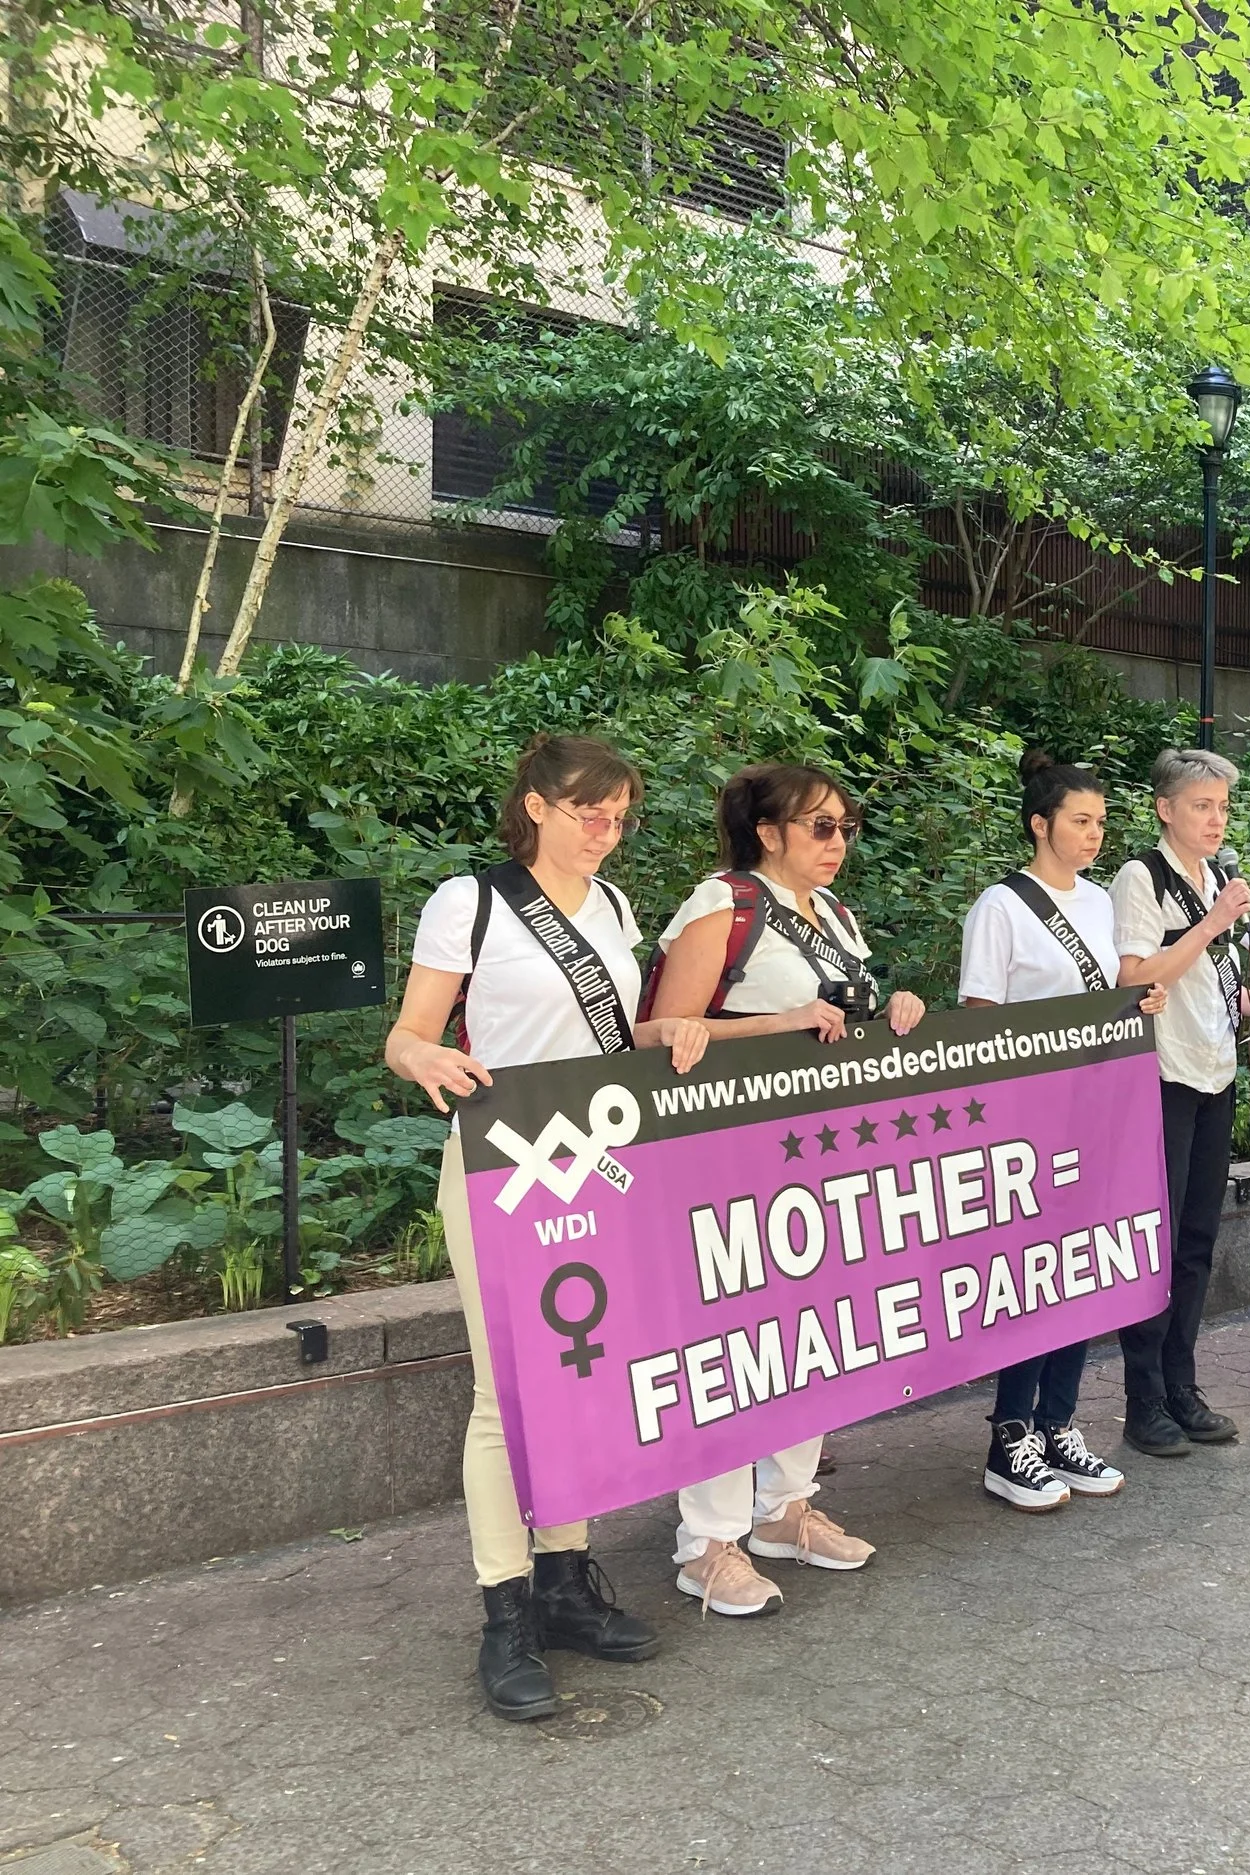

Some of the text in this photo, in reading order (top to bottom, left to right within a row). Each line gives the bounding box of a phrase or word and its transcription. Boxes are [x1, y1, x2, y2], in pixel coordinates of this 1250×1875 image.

[253, 898, 331, 918] CLEAN UP
[254, 914, 351, 936] AFTER YOUR
[255, 938, 290, 954] DOG
[256, 952, 348, 968] Violators subject to fine.
[520, 895, 579, 961] Woman:
[563, 953, 611, 1003] Adult
[1044, 911, 1092, 973] Mother:
[651, 1015, 1144, 1117] www.womensdeclarationusa.com
[597, 1156, 628, 1189] USA
[534, 1210, 597, 1246] WDI
[689, 1138, 1041, 1304] MOTHER
[627, 1208, 1163, 1445] FEMALE PARENT
